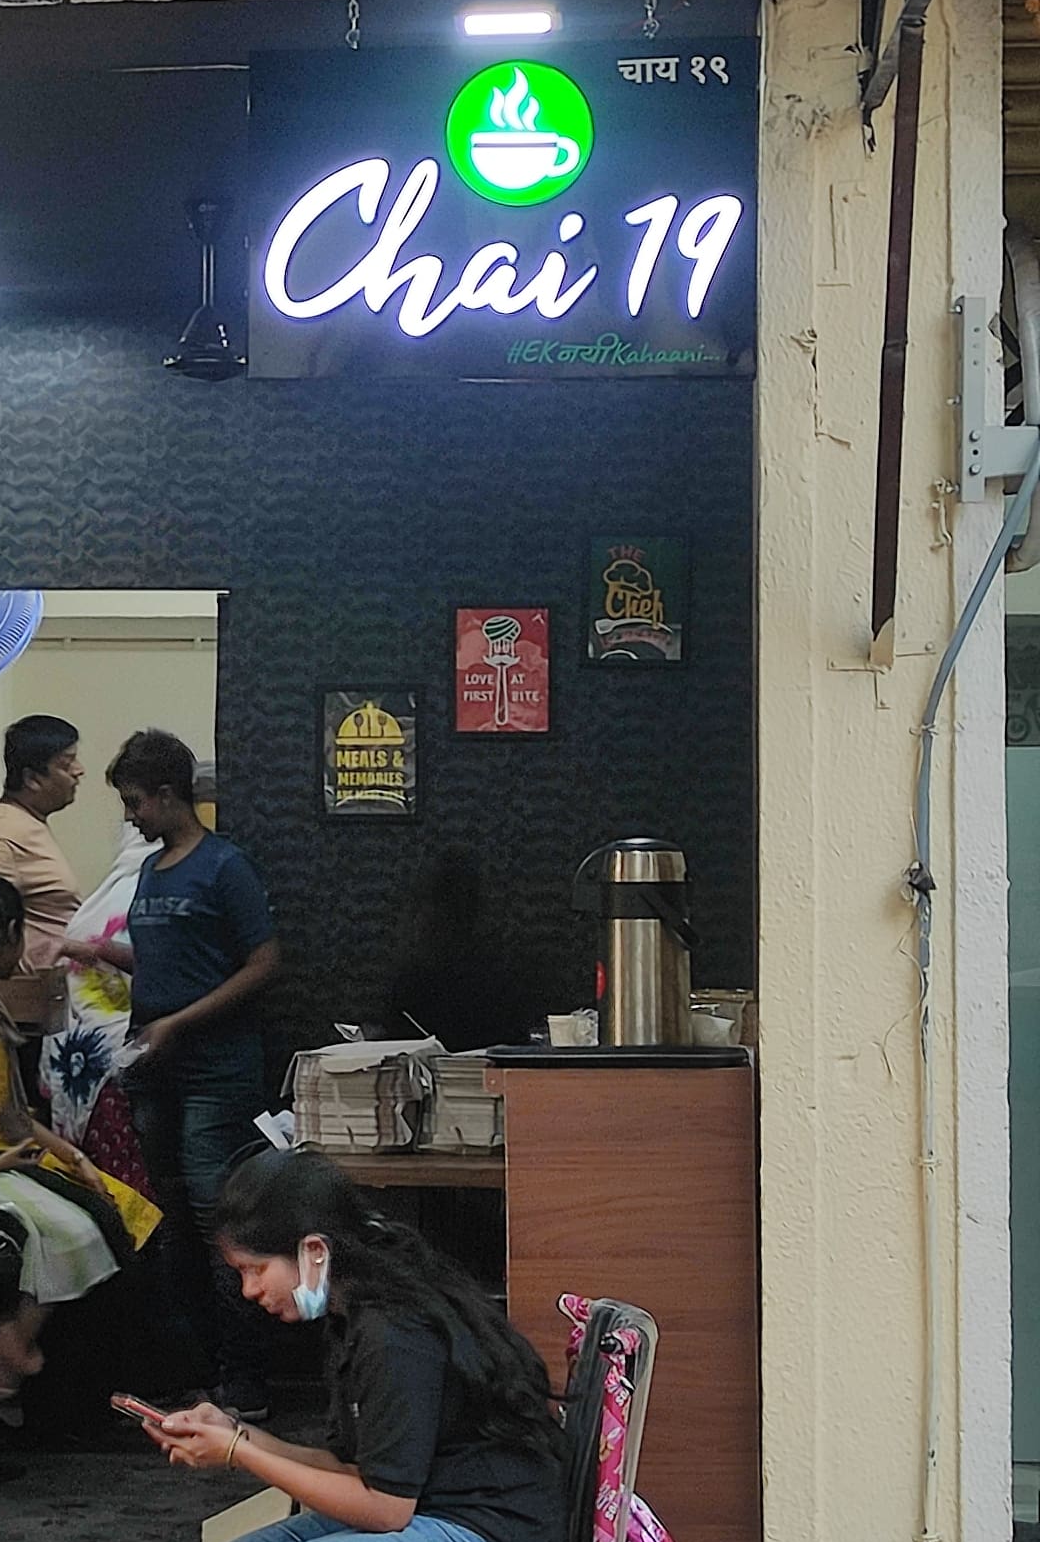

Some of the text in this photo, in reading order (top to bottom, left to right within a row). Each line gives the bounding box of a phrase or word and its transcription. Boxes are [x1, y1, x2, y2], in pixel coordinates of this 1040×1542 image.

[617, 56, 729, 84] चाय १९
[264, 158, 742, 338] Chai 19
[607, 545, 647, 560] THE
[464, 673, 526, 685] LOVE AT
[463, 690, 540, 702] FIRST BITE
[336, 750, 405, 768] MEALS &
[337, 771, 405, 787] MEMORIES
